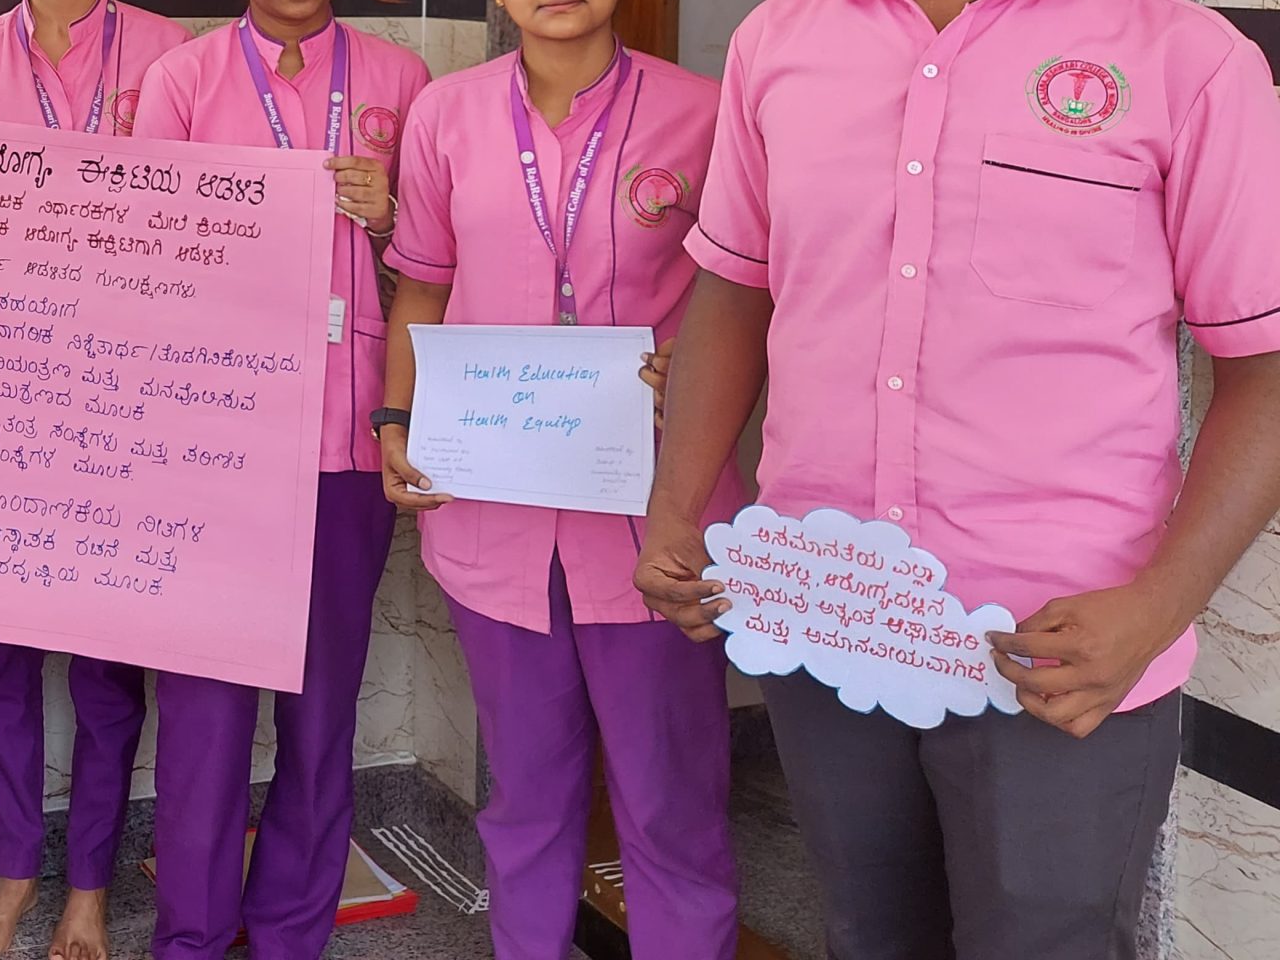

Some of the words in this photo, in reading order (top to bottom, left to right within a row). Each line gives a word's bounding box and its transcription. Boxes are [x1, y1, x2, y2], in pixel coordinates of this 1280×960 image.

[263, 92, 280, 124] Nursing
[580, 131, 603, 166] Nursing
[578, 163, 589, 177] of
[567, 176, 586, 212] College
[81, 366, 120, 392] ಮತ್ತು
[463, 362, 512, 382] Health
[517, 364, 601, 389] Education
[511, 391, 536, 405] on
[457, 408, 509, 430] Health
[130, 438, 168, 466] ಮತ್ತು
[135, 545, 178, 573] ಮತ್ತು
[745, 613, 790, 646] ಮತ್ತು
